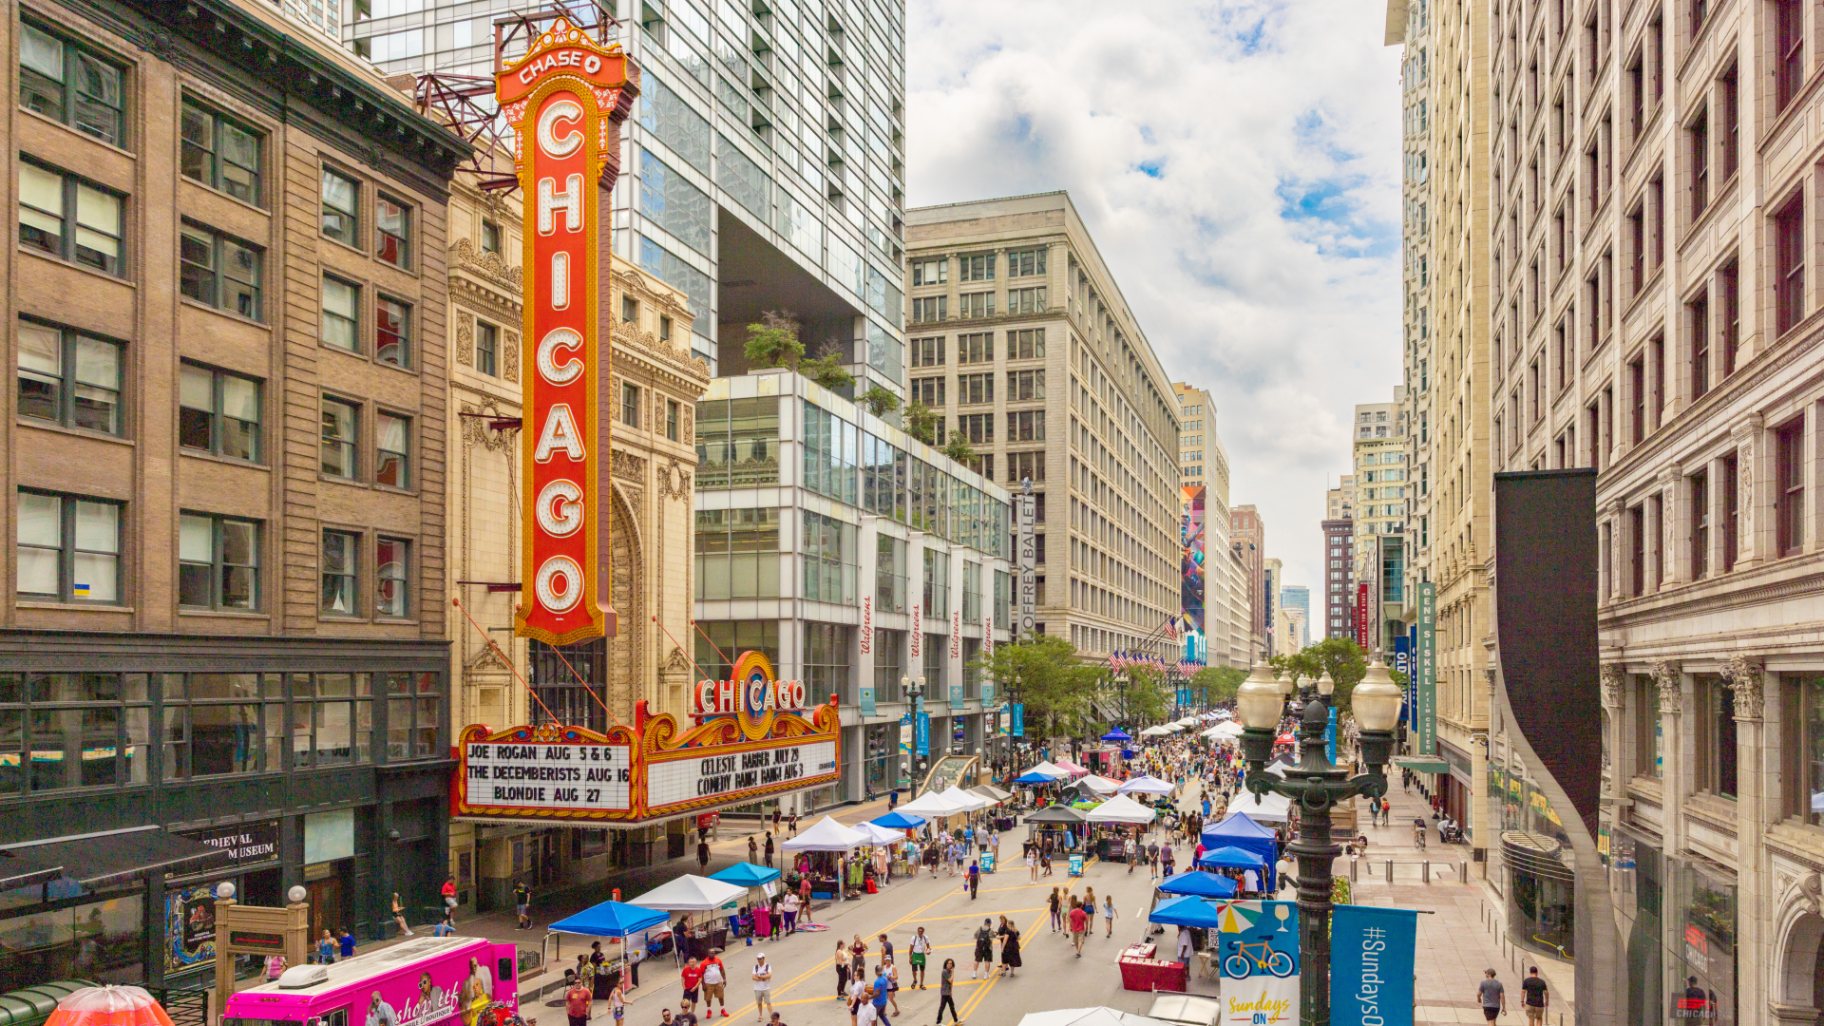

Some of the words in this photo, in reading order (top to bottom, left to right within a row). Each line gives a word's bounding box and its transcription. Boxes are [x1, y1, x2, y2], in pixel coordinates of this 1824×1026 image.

[519, 50, 583, 84] CHASE
[535, 99, 586, 614] CHICAGO
[1023, 498, 1034, 558] BALLET
[1423, 588, 1431, 624] GENE
[860, 596, 873, 655] Walgreens
[911, 605, 921, 657] Walgreens
[950, 608, 960, 659] Walgreens
[1396, 651, 1407, 674] OLD
[1423, 630, 1431, 685] SISKEL
[701, 679, 805, 713] CHICAGO
[468, 745, 489, 759] JOE
[497, 746, 537, 760] ROGAN
[545, 746, 570, 760] AUG
[579, 747, 587, 760] 5
[590, 747, 600, 761] &
[604, 747, 612, 761] 6
[701, 755, 737, 776] CELESTE
[773, 748, 789, 765] JULY
[791, 747, 799, 762] 29
[468, 765, 489, 779] THE
[493, 766, 581, 781] DECEMBERISTS
[586, 768, 612, 782] AUG
[617, 768, 629, 782] 16
[697, 773, 732, 795] COMEDY
[784, 764, 798, 780] AUG
[494, 786, 546, 801] BLONDIE
[553, 788, 579, 802] AUG
[586, 788, 601, 802] 27
[203, 833, 252, 848] DIEVAL
[228, 843, 273, 859] MUSEUM
[394, 997, 432, 1024] shop
[438, 981, 459, 1012] ttf
[426, 1008, 451, 1020] BOUTIQUE
[1228, 991, 1290, 1025] Sundays
[1253, 1013, 1267, 1025] ON
